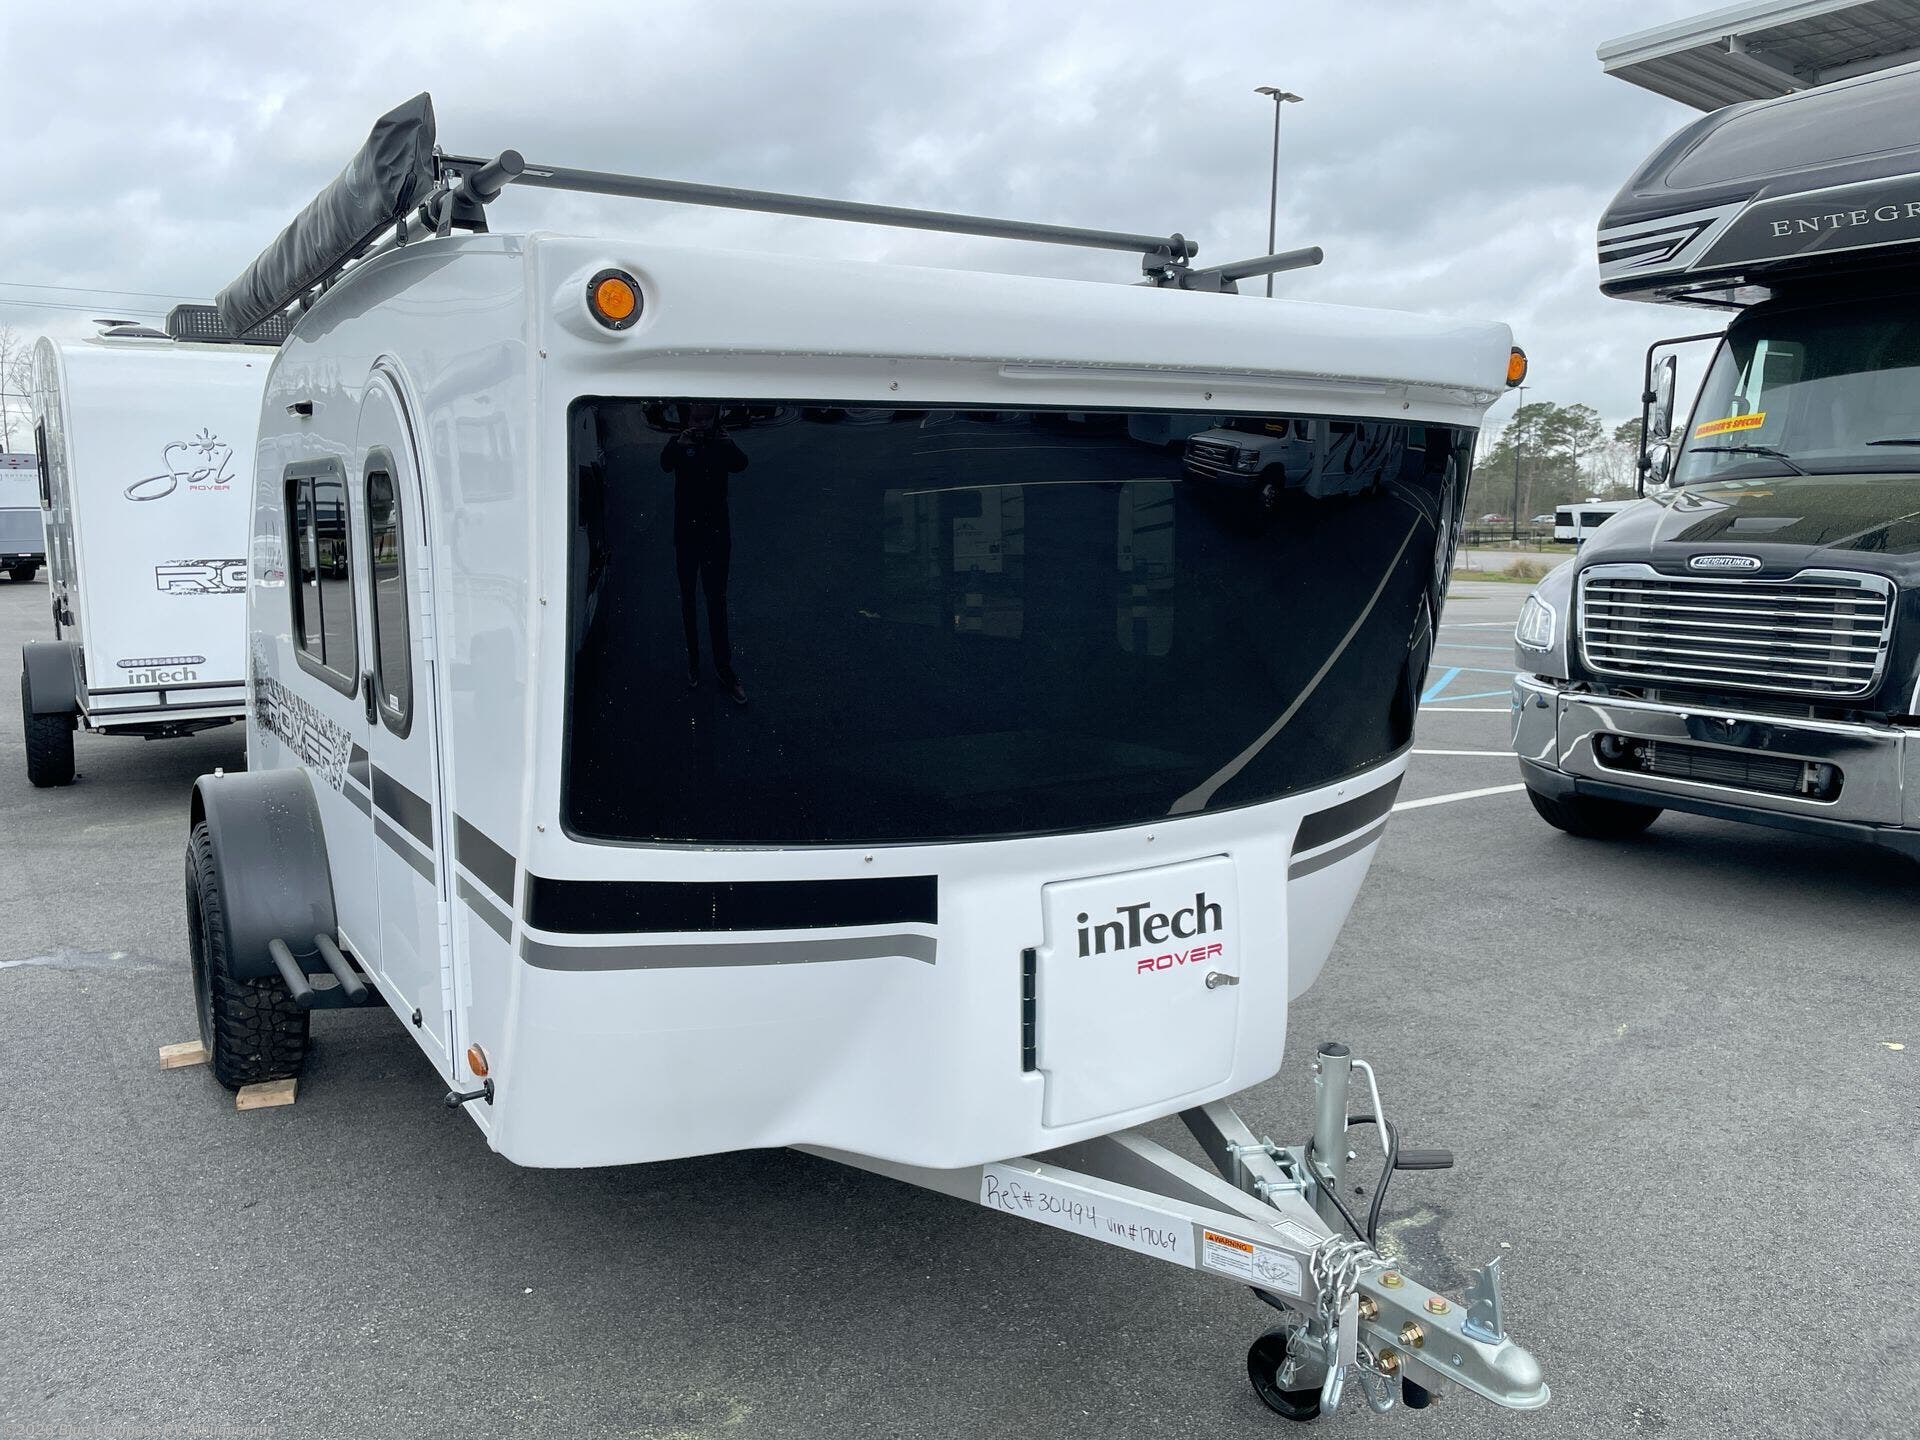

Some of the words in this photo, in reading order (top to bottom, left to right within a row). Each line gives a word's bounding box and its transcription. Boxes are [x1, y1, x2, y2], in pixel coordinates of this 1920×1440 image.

[1698, 558, 1752, 567] FREIGHTLINER
[128, 667, 197, 684] inTech
[1077, 892, 1223, 958] inTech
[1137, 943, 1223, 974] ROVER
[1214, 1235, 1248, 1251] WARNING
